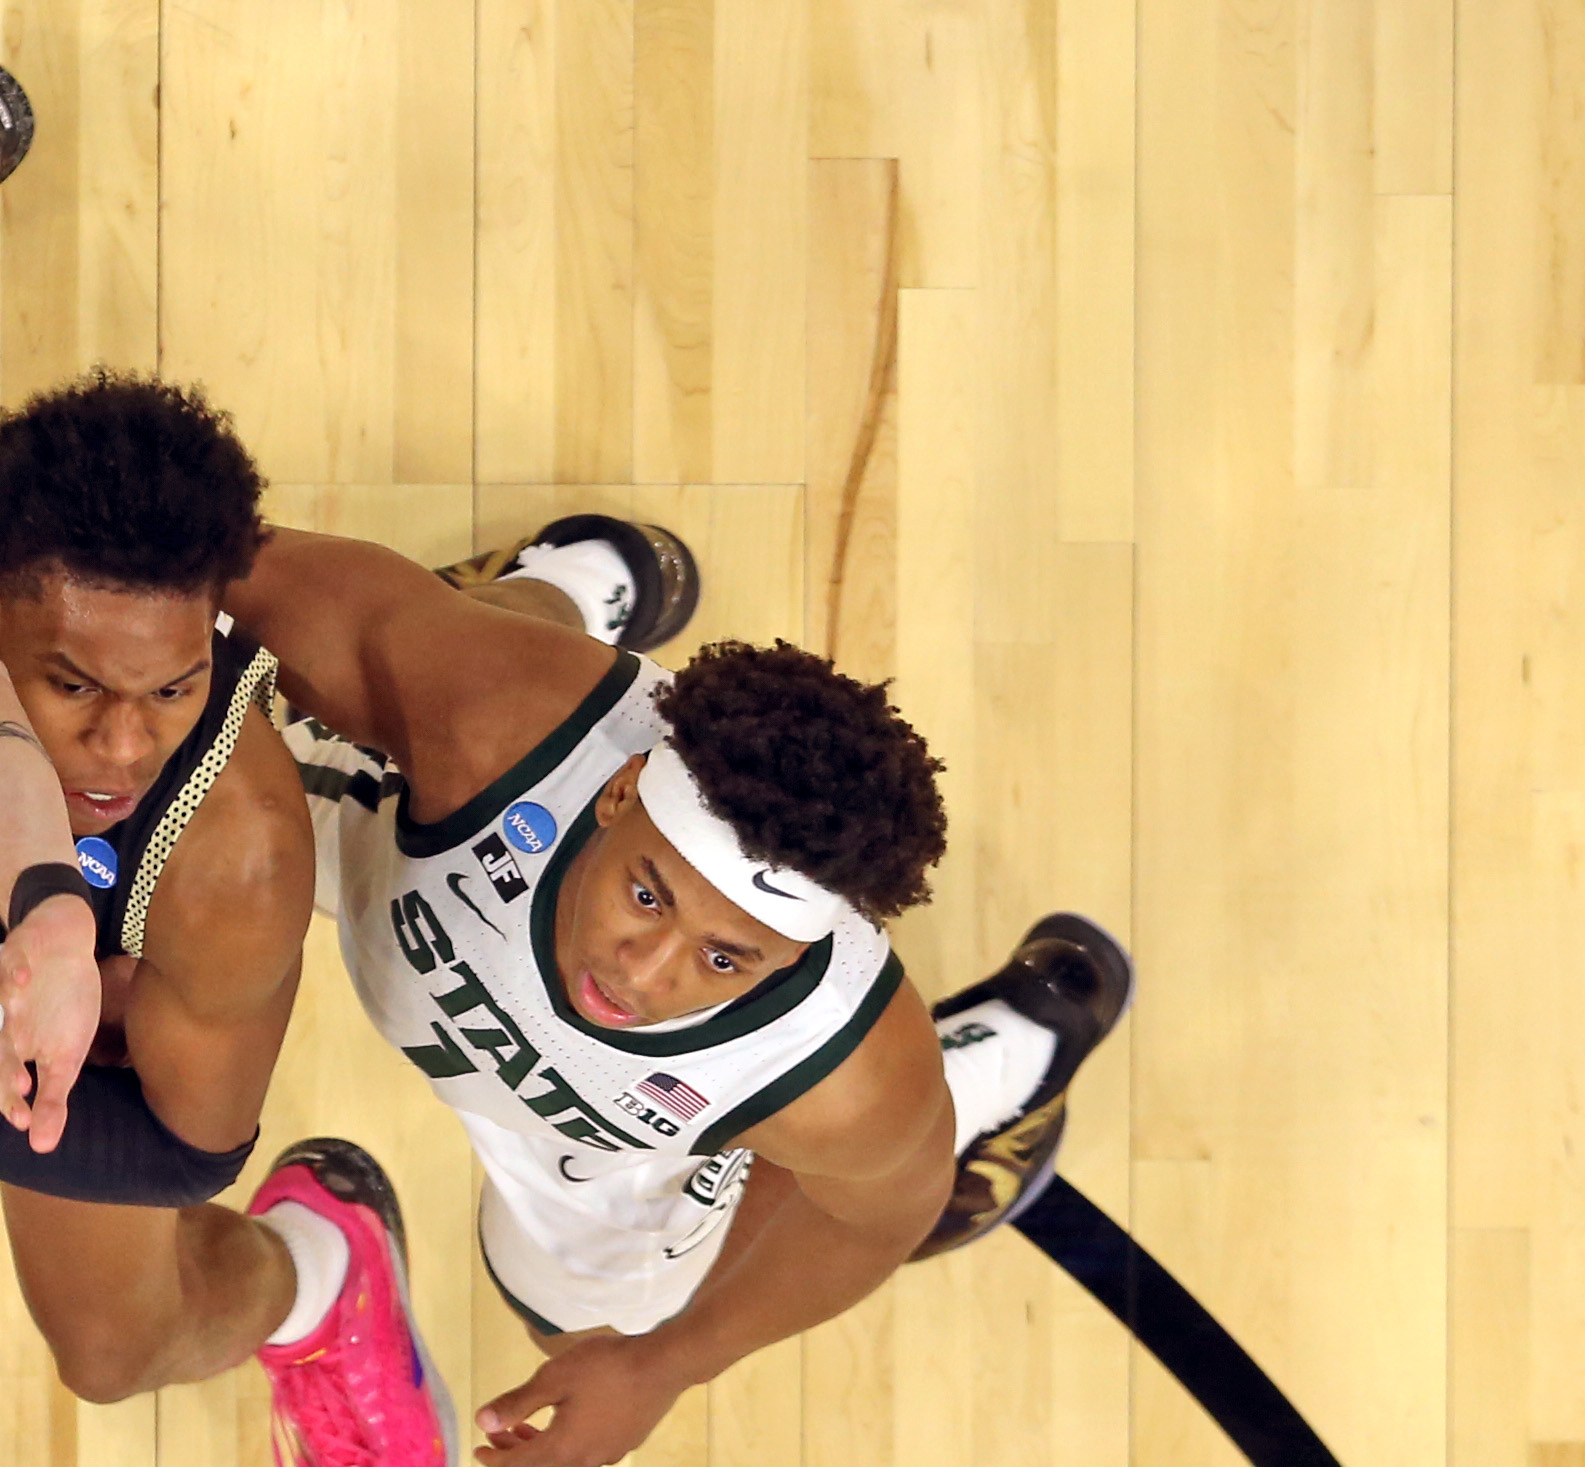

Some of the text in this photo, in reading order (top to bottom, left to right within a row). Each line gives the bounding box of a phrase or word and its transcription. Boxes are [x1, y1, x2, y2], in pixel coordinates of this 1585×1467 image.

[507, 812, 543, 852] NCAA
[78, 851, 115, 885] NCAA
[482, 850, 521, 883] JF
[390, 889, 658, 1153] STATE
